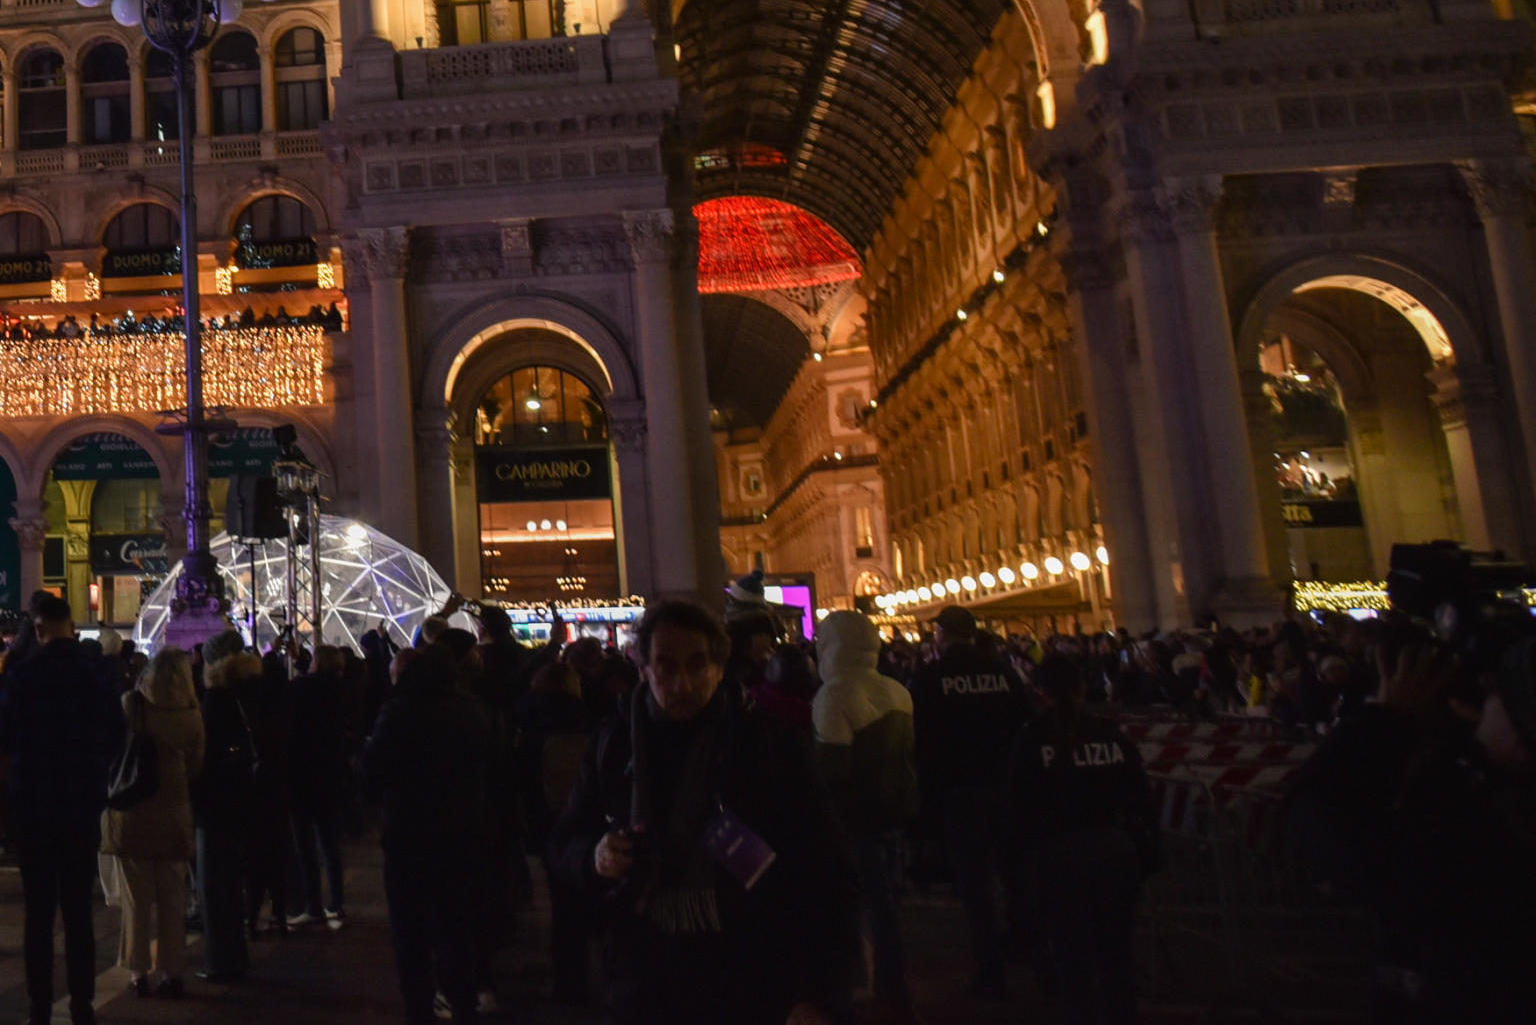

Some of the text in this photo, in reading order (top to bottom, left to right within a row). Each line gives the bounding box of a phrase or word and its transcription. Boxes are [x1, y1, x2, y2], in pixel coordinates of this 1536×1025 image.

[296, 242, 311, 256] 21
[35, 260, 49, 273] 21
[112, 253, 161, 269] DUOMO
[495, 459, 592, 481] CAMPARINO
[941, 674, 1010, 696] POLIZIA
[1040, 741, 1126, 768] PLIZIA
